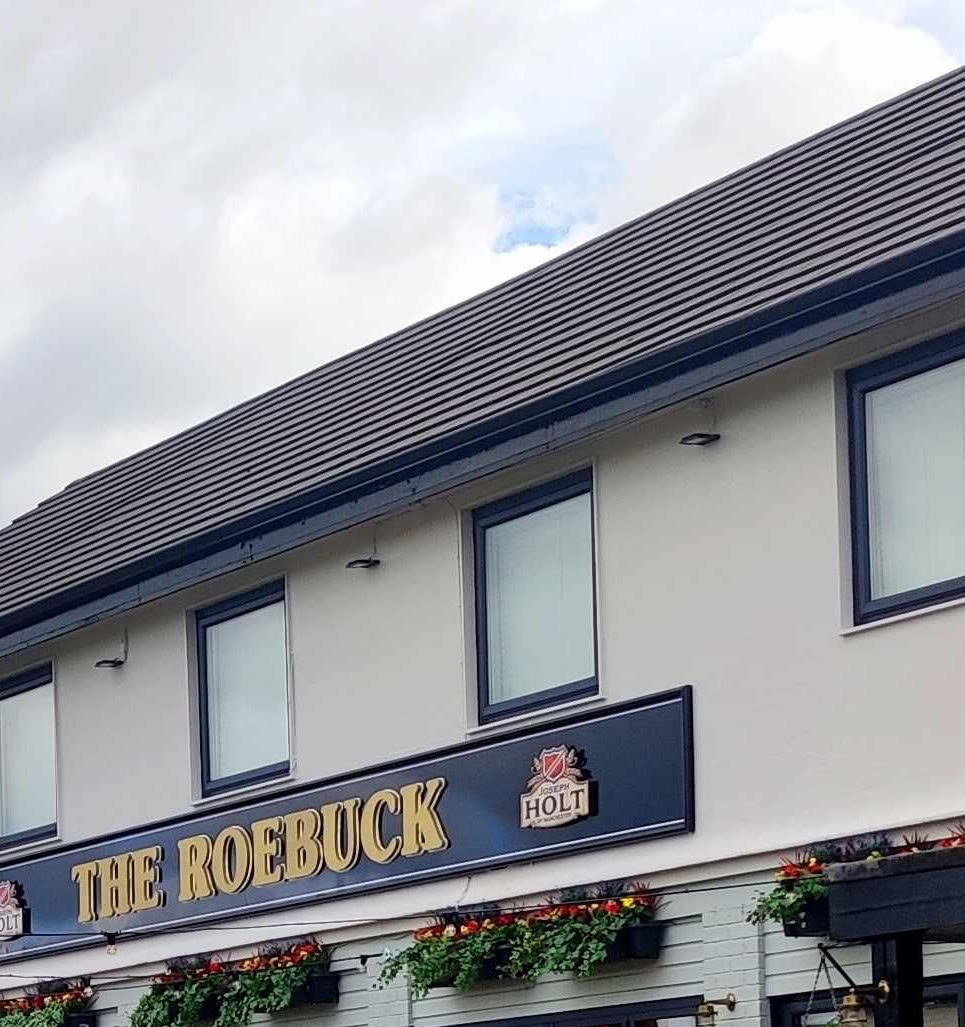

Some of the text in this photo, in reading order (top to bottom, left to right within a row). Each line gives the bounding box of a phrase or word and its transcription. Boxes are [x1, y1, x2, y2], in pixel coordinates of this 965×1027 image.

[525, 788, 585, 820] HOLT
[538, 783, 570, 796] JOSEPH
[71, 775, 452, 924] THE ROEBUCK
